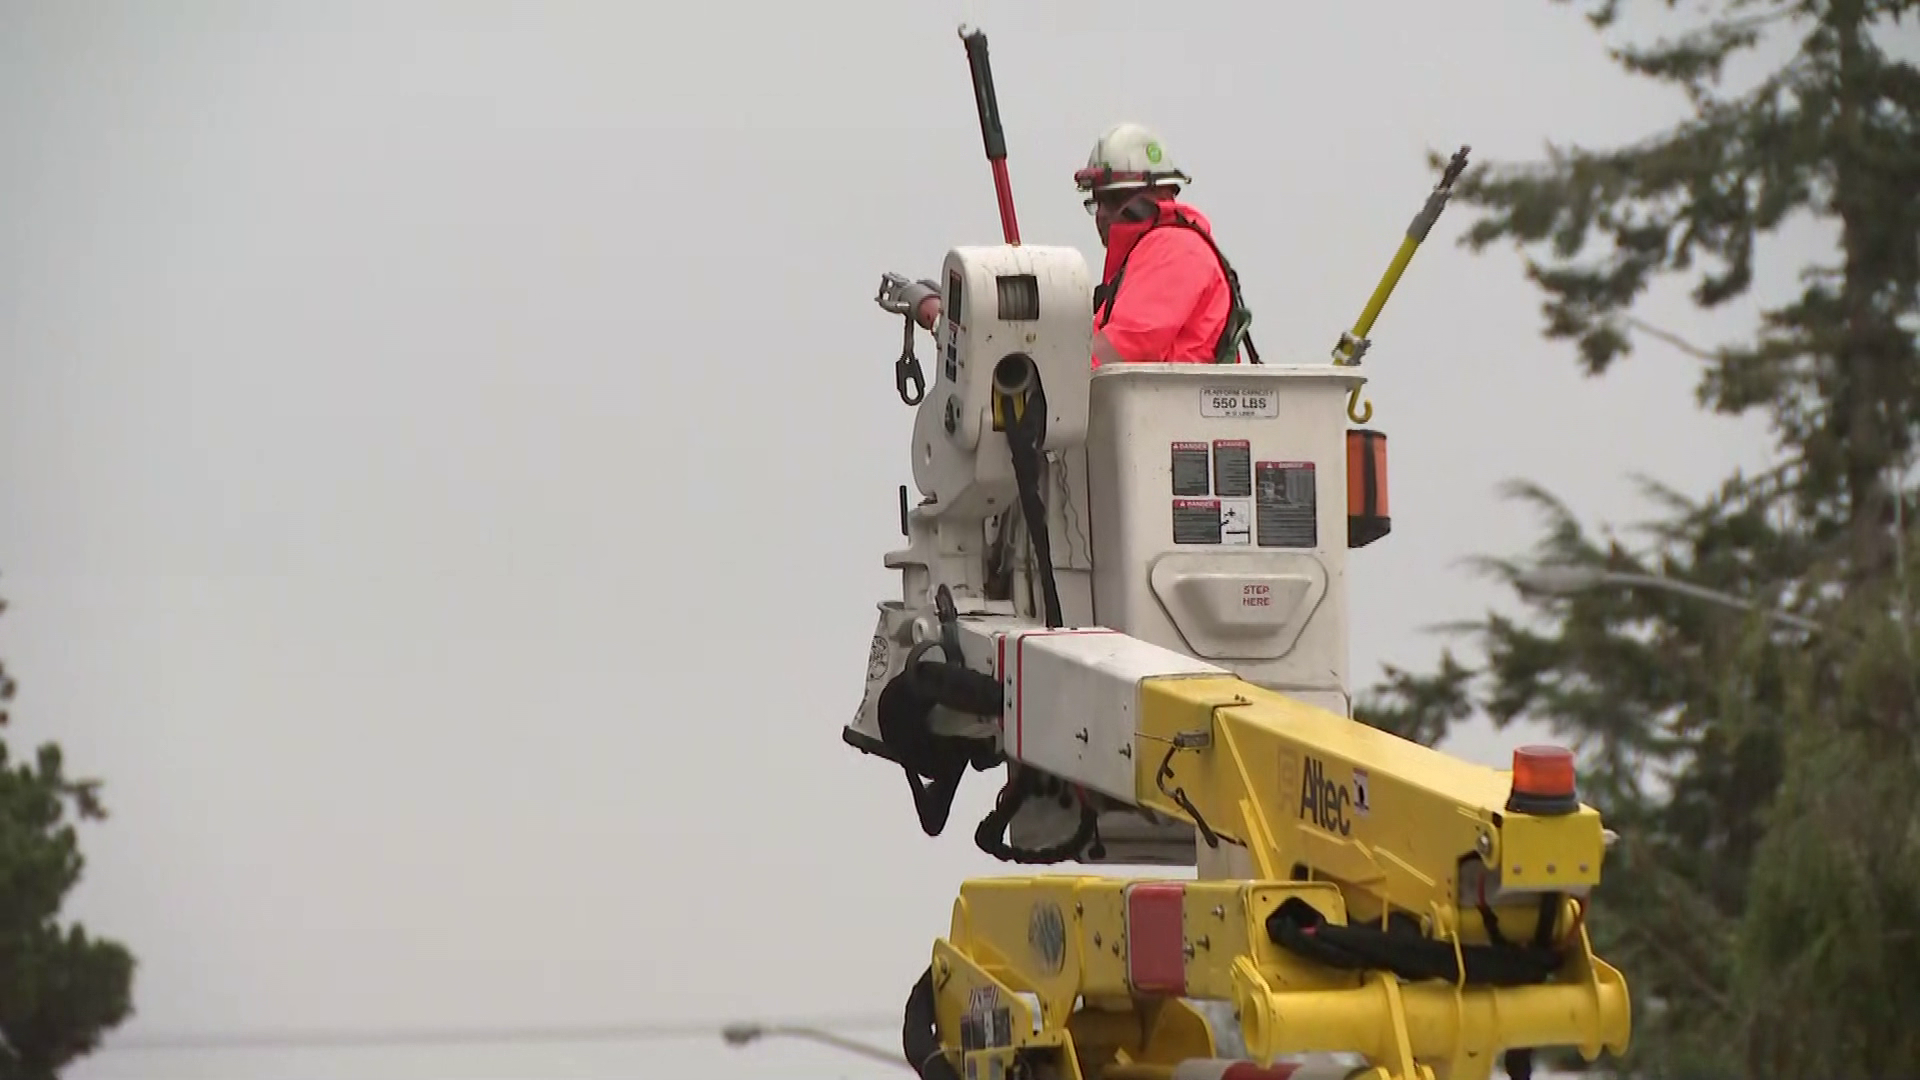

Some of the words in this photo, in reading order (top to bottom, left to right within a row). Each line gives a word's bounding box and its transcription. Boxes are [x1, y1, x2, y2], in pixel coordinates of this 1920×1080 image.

[1212, 397, 1237, 409] 550
[1242, 397, 1267, 409] LBS
[1243, 585, 1270, 595] STEP
[1243, 597, 1271, 607] HERE
[1300, 756, 1351, 837] Altec
